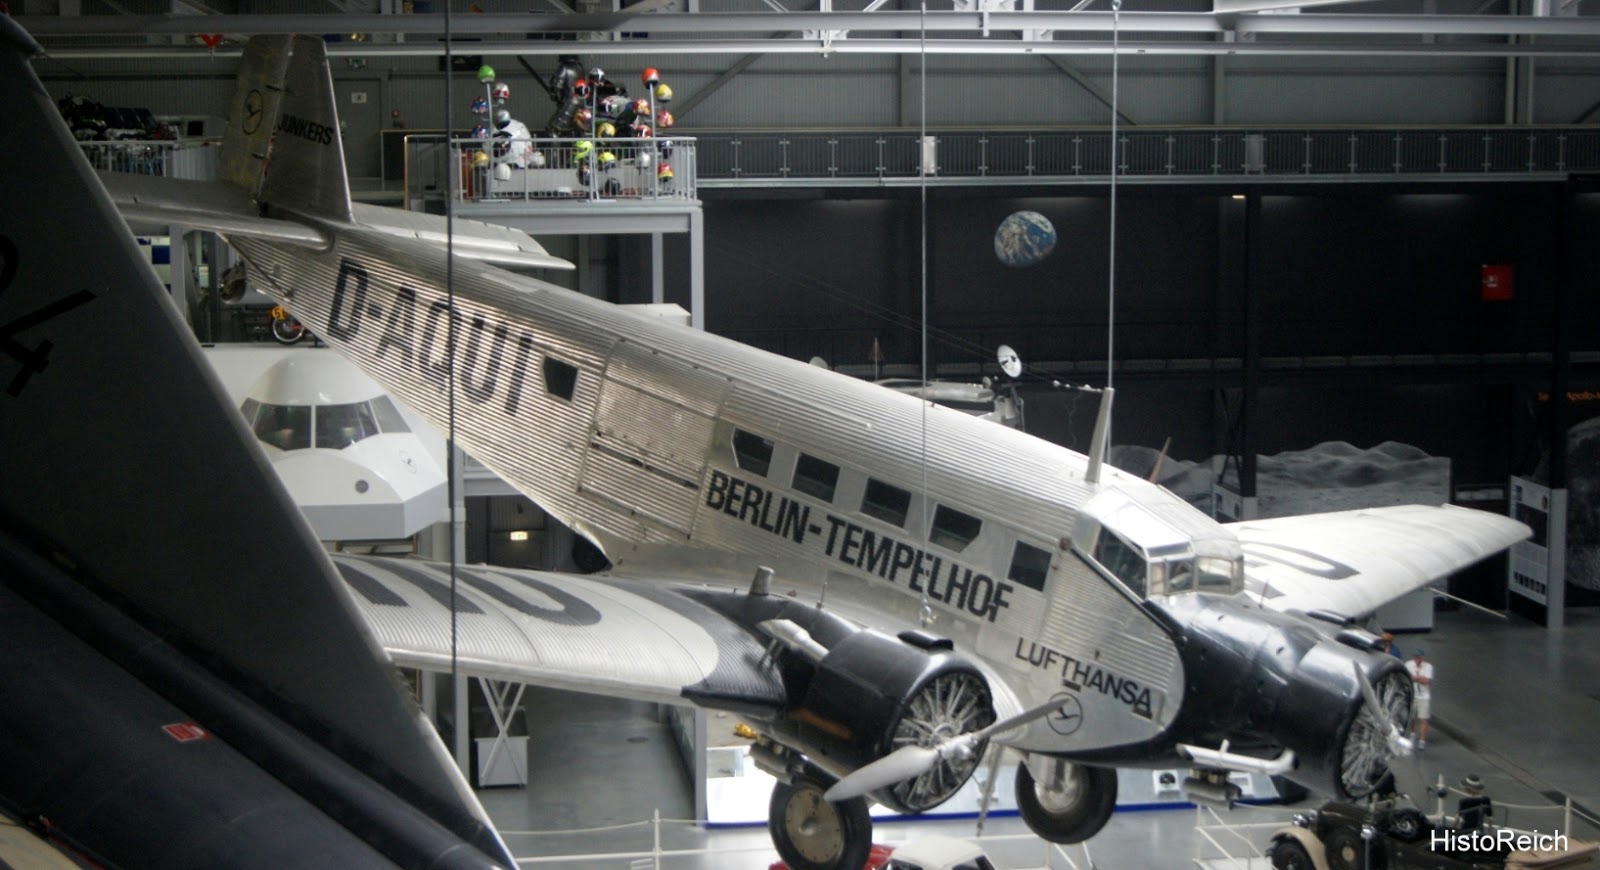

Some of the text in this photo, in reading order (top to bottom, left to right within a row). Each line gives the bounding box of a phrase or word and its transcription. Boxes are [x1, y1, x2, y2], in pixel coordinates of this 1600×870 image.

[278, 113, 334, 145] JUNKERS
[326, 256, 534, 416] D-AQUI
[705, 468, 1014, 623] BERLIN-TEMPELHOF
[1015, 637, 1152, 717] LUFTHANSA
